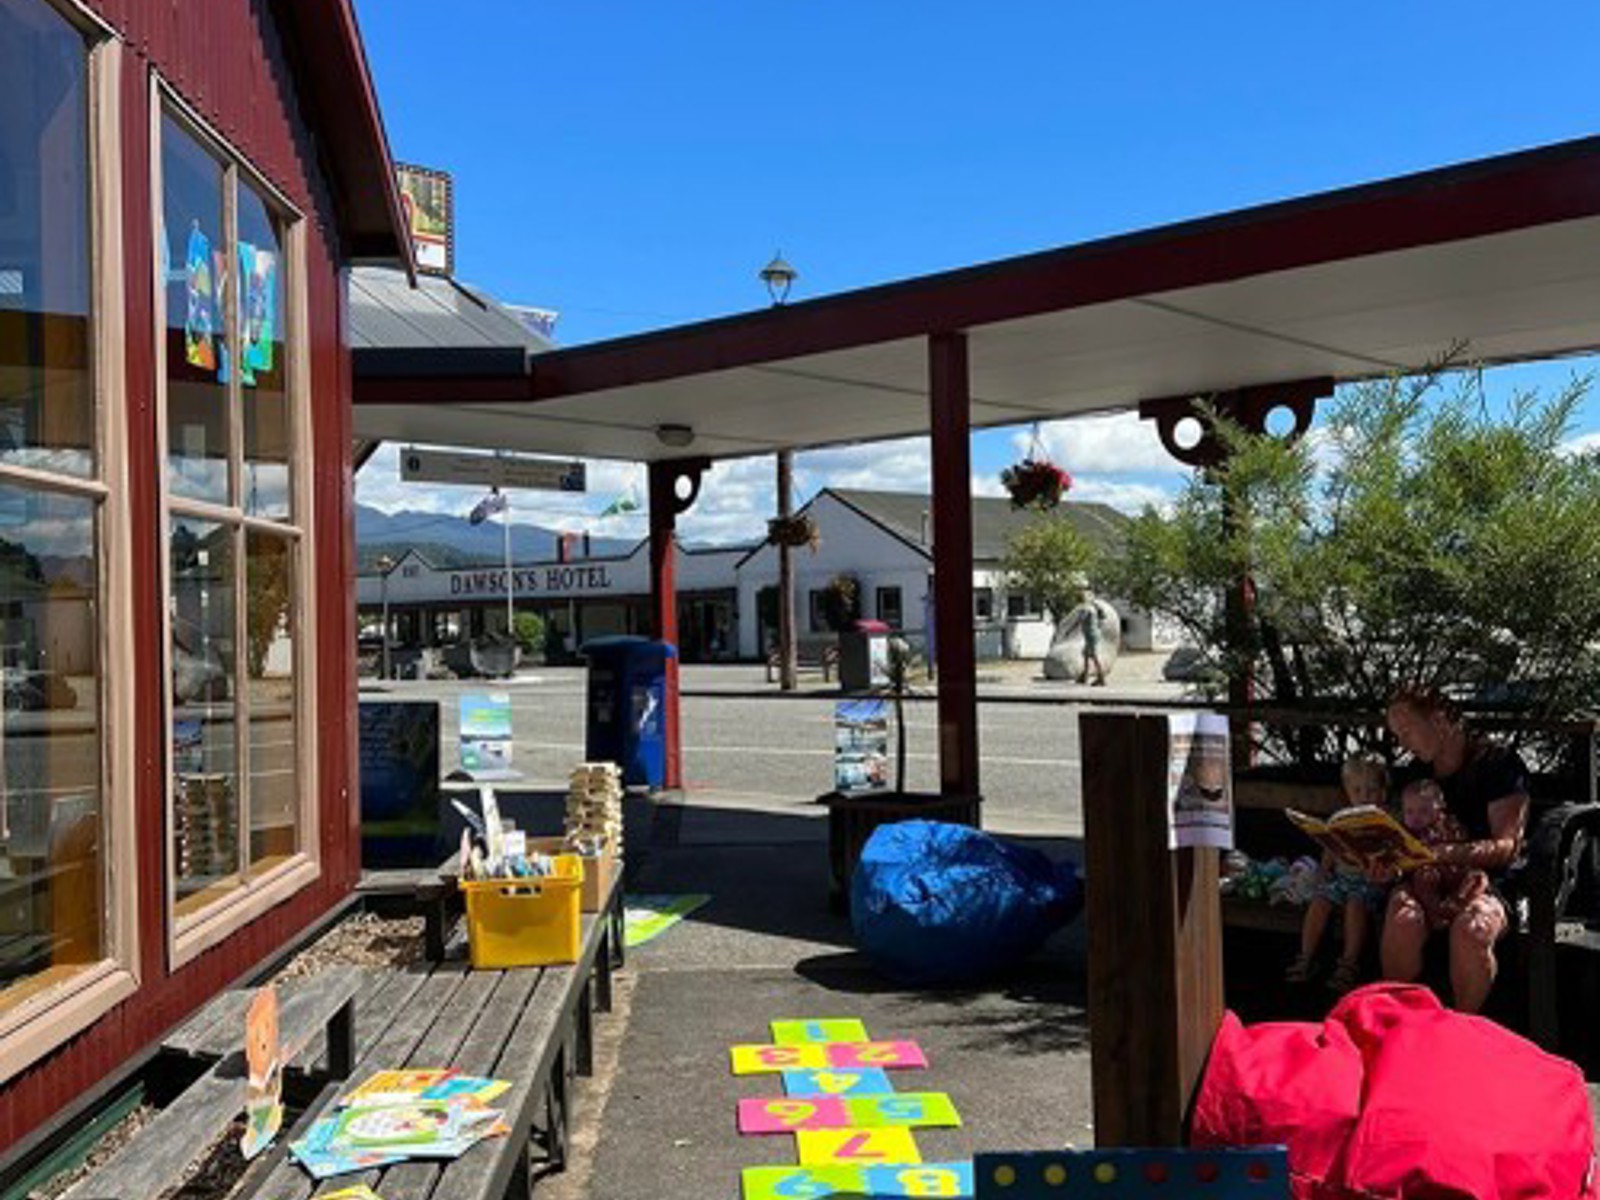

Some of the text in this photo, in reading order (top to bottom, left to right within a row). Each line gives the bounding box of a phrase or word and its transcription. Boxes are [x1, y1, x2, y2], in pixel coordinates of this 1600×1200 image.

[451, 567, 612, 594] DAWSON'S HOTEL
[808, 1071, 860, 1093] 4
[877, 1097, 922, 1118] 5
[832, 1132, 886, 1157] 7
[897, 1168, 960, 1196] 8
